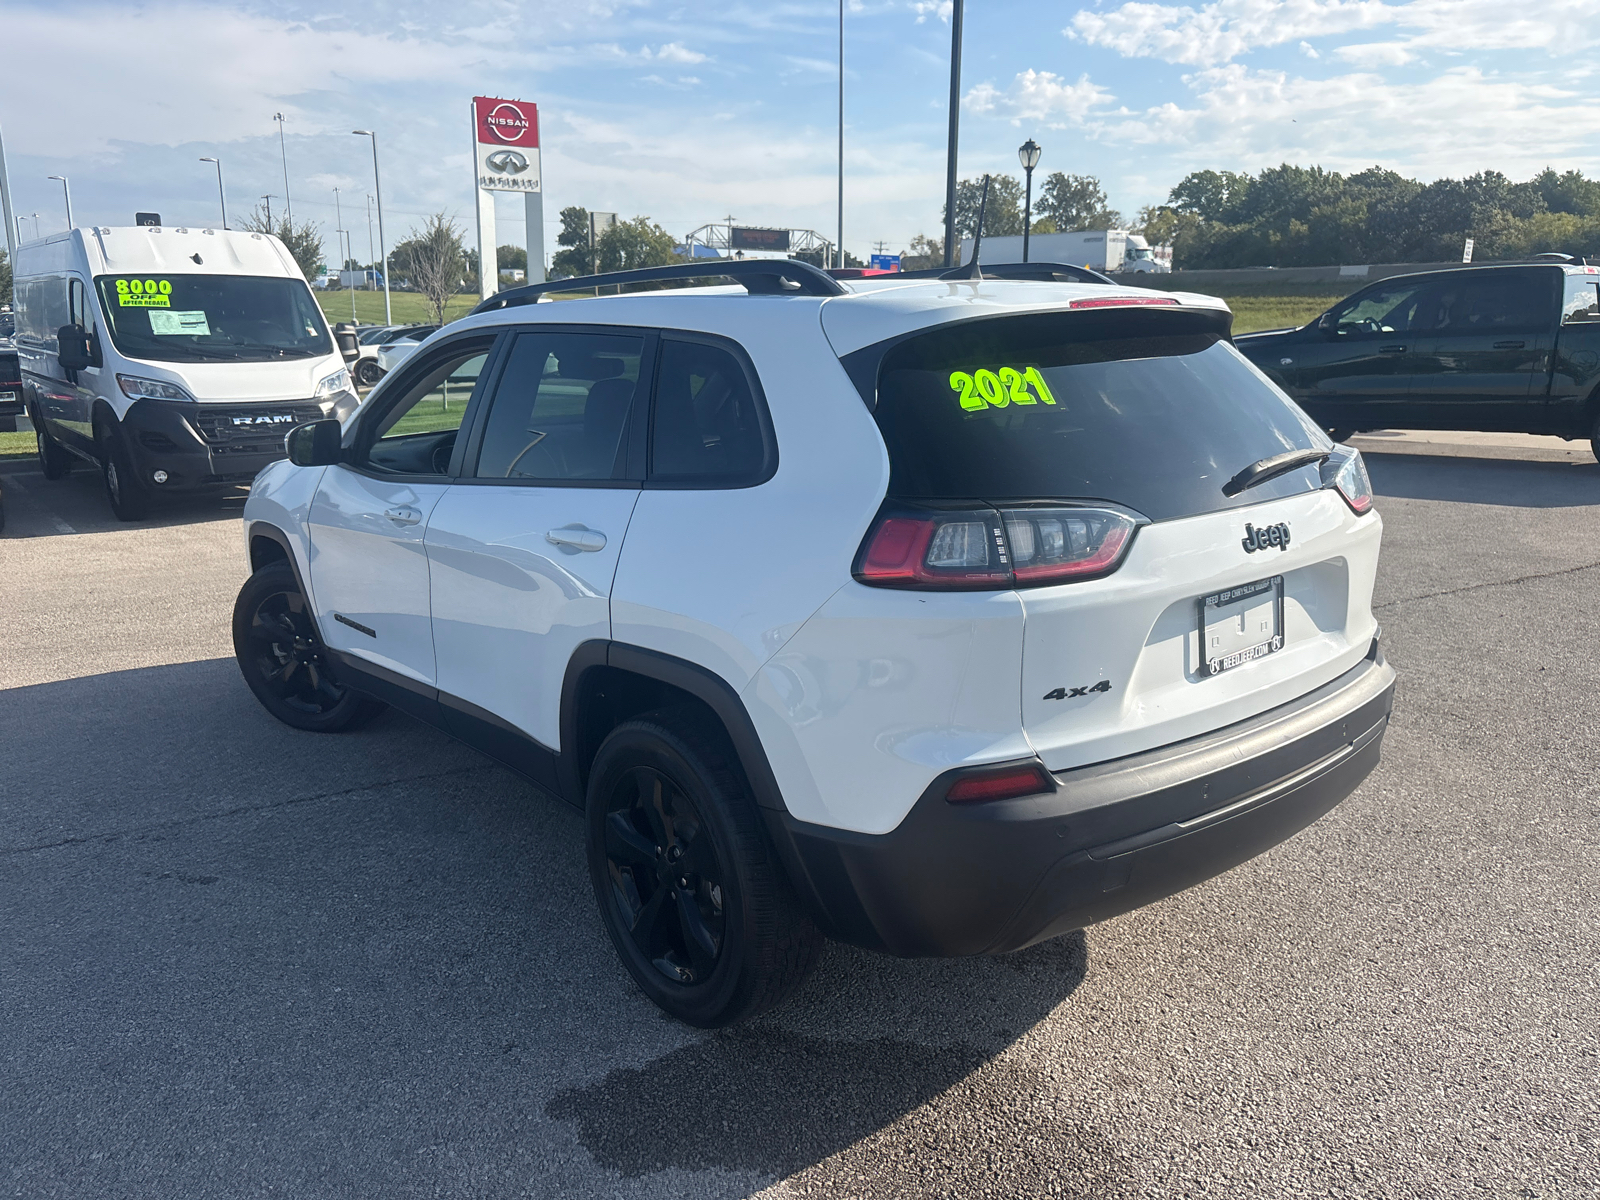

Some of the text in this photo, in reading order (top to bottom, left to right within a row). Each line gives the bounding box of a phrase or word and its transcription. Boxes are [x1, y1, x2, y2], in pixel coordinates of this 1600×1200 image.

[487, 116, 529, 128] NISSAN
[481, 176, 539, 188] INFINITI
[115, 279, 173, 295] 8000
[949, 366, 1057, 412] 2021
[232, 415, 293, 425] RAM
[1241, 522, 1291, 554] Jeep
[1205, 595, 1219, 606] REED
[1220, 591, 1231, 601] JEEP
[1223, 643, 1269, 670] REEDJEEP.COM
